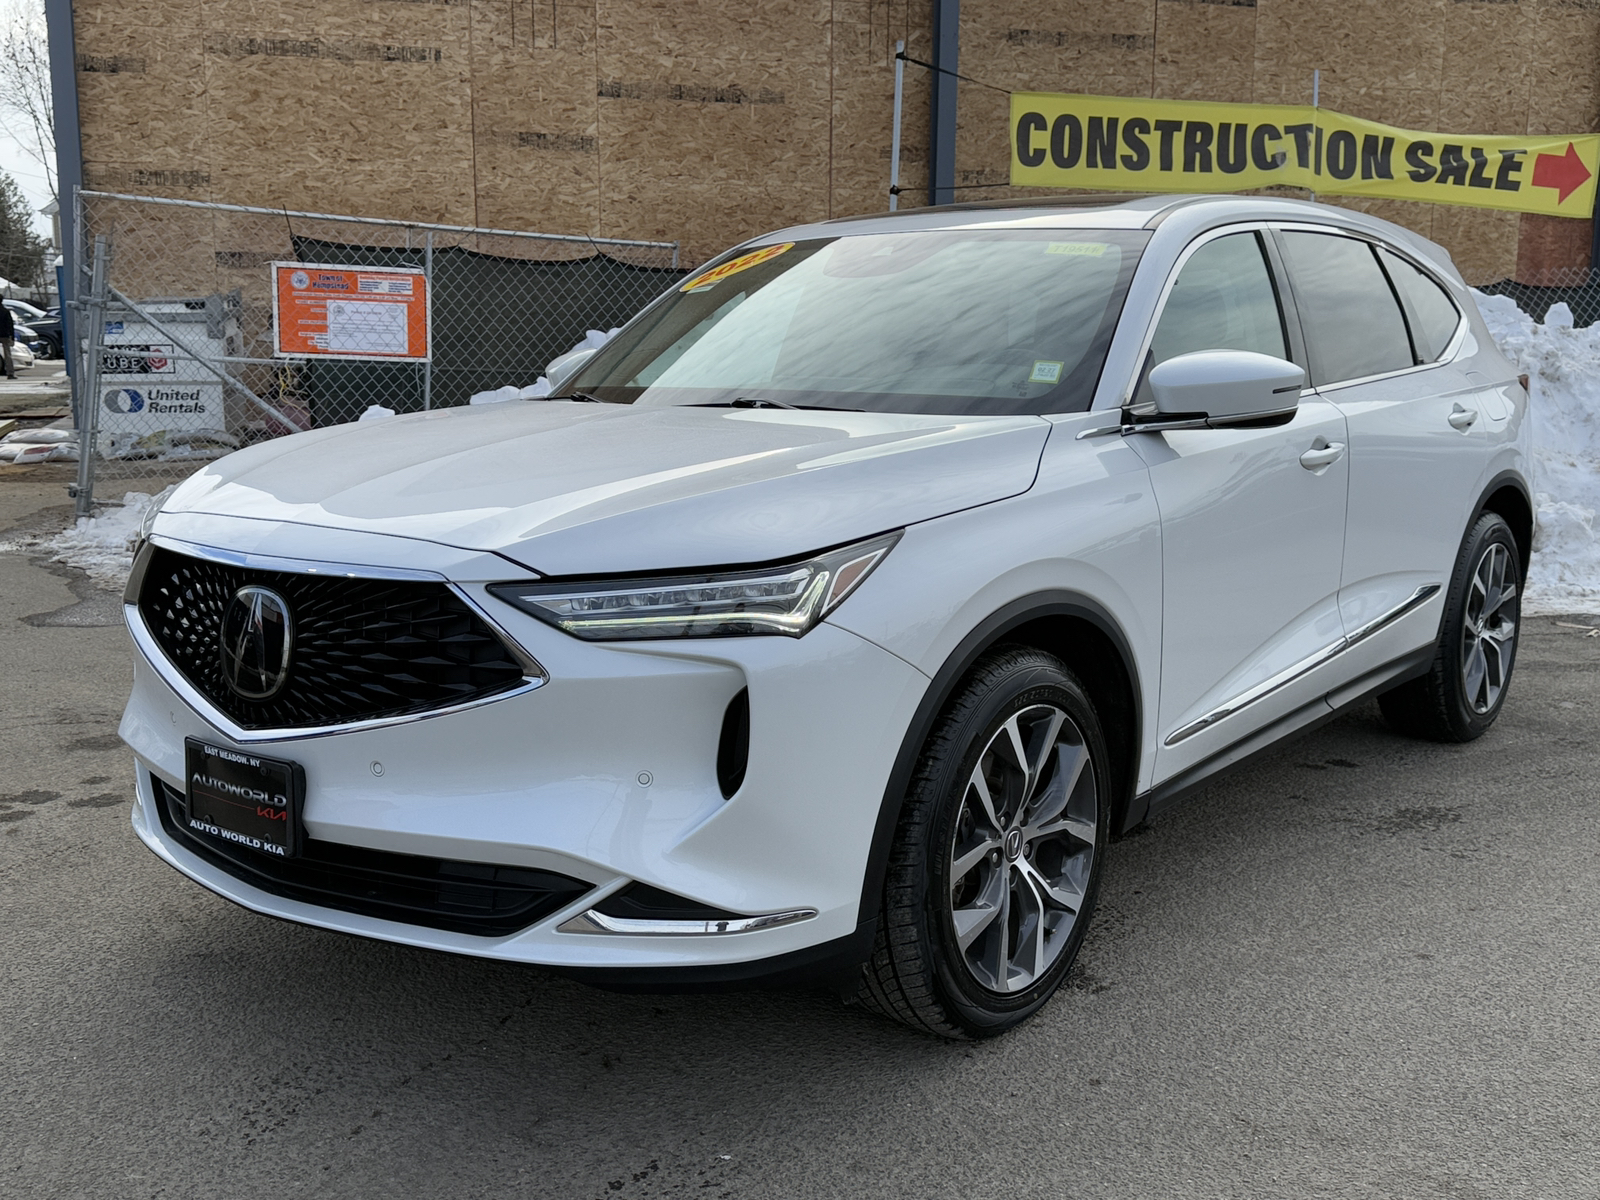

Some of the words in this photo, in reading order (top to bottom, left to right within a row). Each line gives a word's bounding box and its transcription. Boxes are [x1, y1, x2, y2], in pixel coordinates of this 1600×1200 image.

[1016, 111, 1395, 181] CONSTRUCTION
[1405, 140, 1527, 192] SALE
[692, 244, 785, 288] 2022
[148, 389, 200, 401] United
[148, 402, 206, 414] Rentals
[204, 745, 219, 757] EAST
[250, 758, 261, 768] NY
[192, 772, 287, 808] AUTOWORLD
[257, 806, 287, 821] KIA
[190, 819, 219, 835] AUTO
[221, 828, 261, 848] WORLD
[263, 842, 285, 856] KIA
